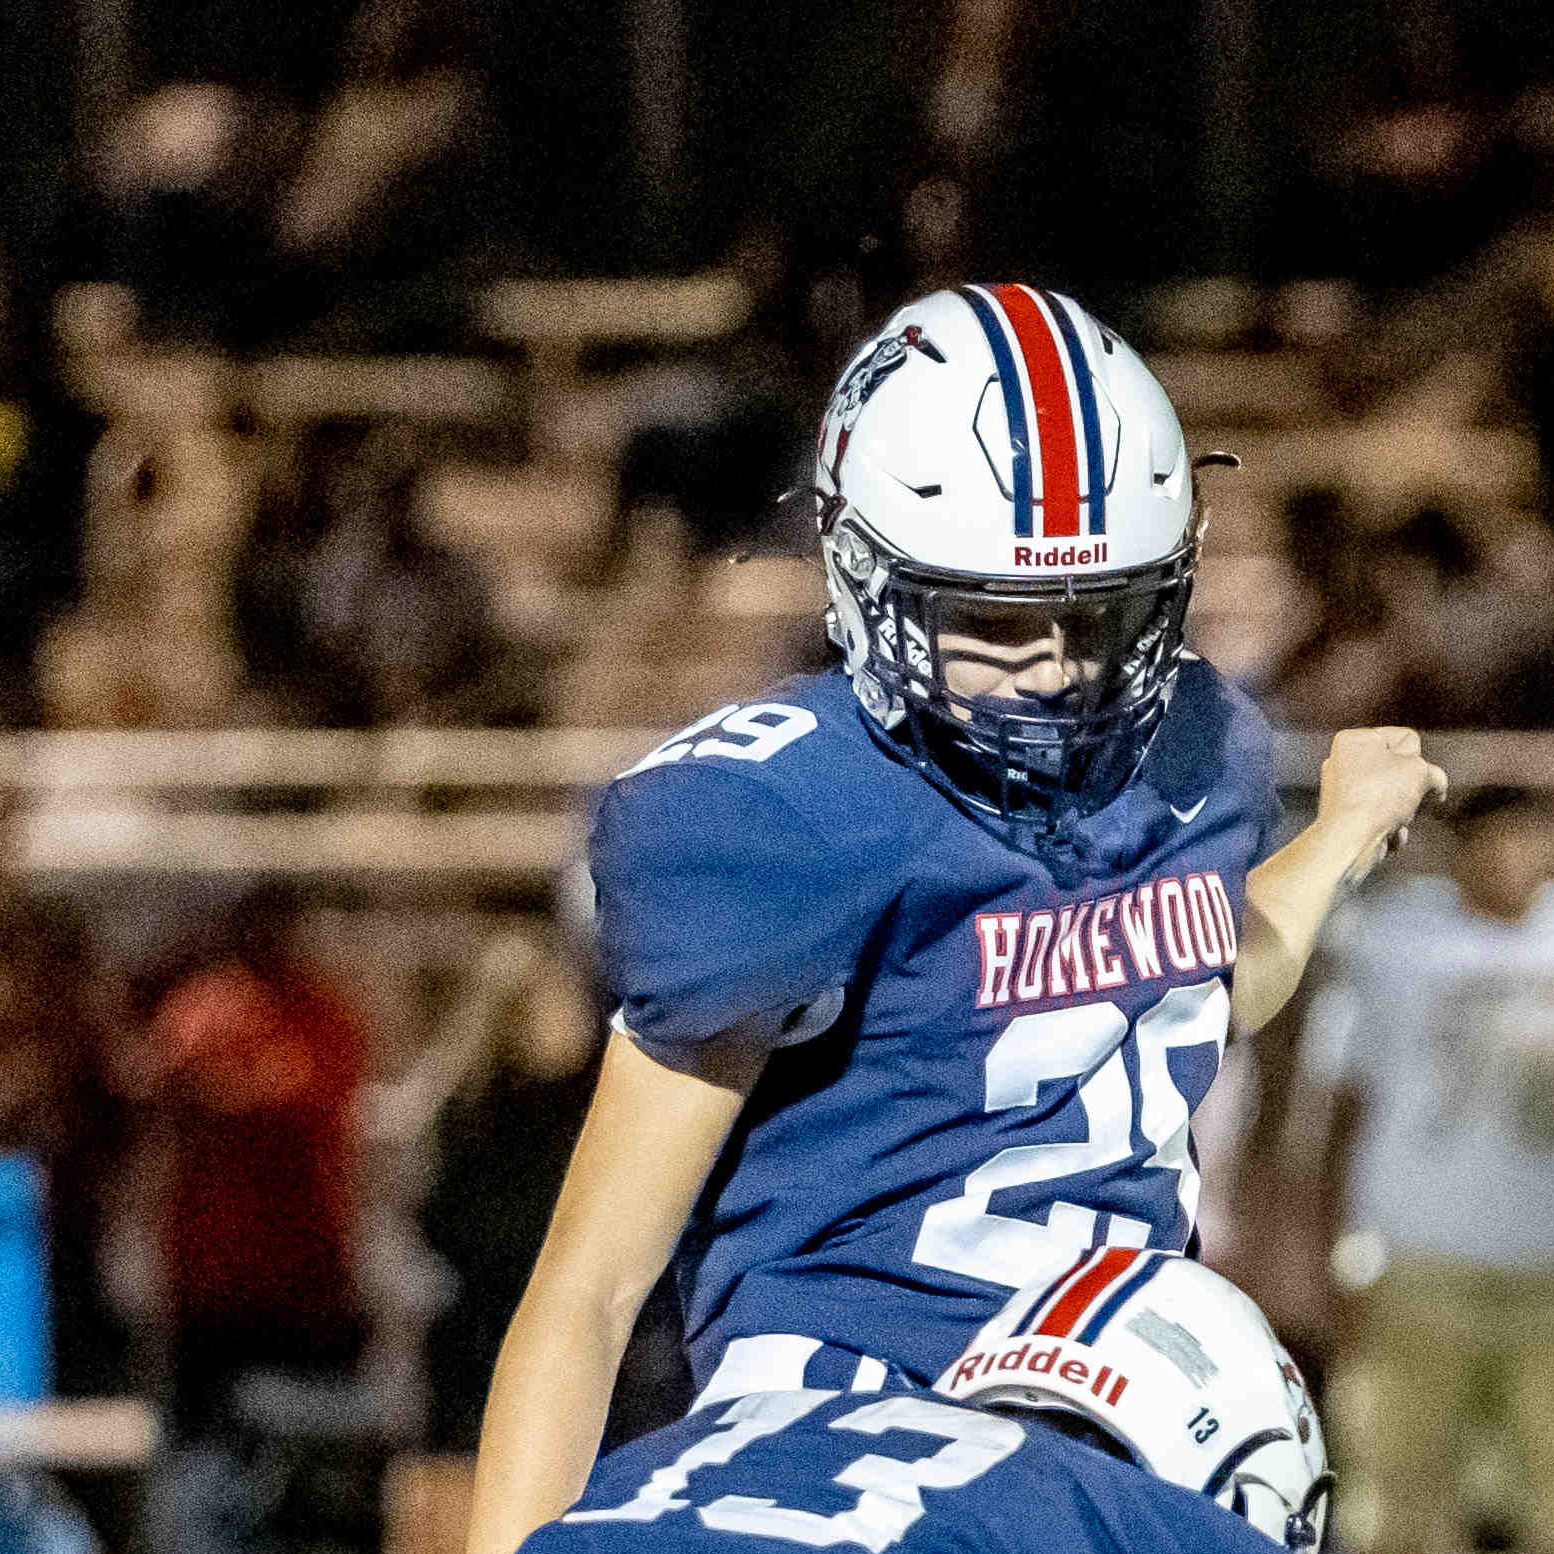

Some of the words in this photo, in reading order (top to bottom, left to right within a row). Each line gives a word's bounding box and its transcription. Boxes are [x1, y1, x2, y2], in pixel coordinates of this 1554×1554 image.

[1014, 542, 1108, 567] Riddell
[975, 871, 1237, 1009] HOMEWOOD
[949, 1342, 1130, 1408] Riddell
[1187, 1406, 1220, 1444] 13
[562, 1388, 1026, 1554] 13
